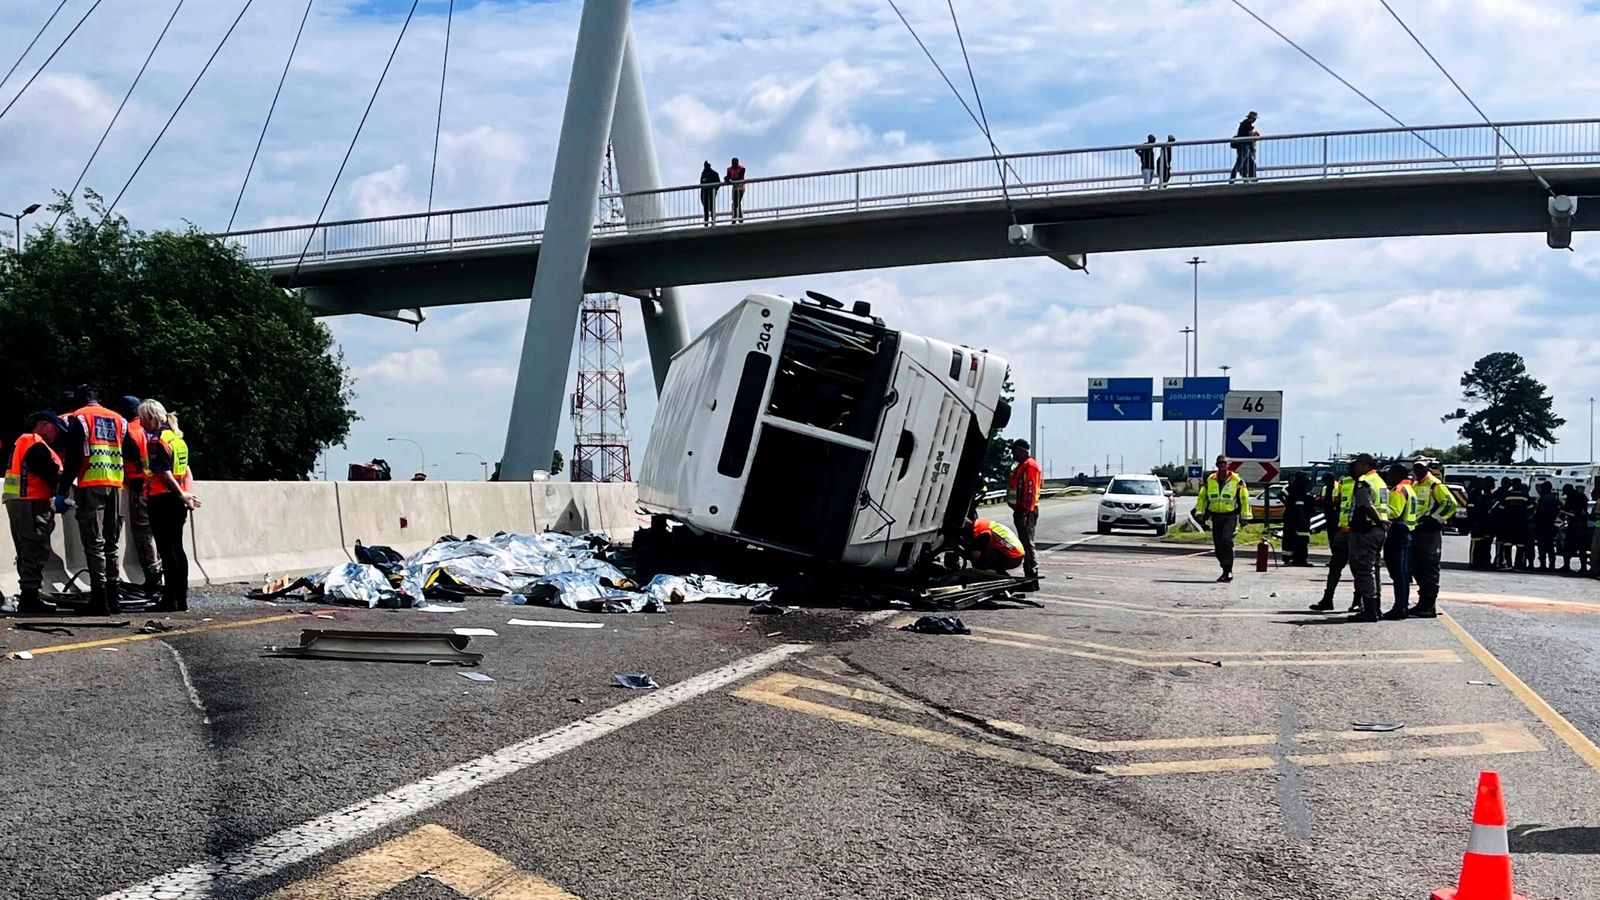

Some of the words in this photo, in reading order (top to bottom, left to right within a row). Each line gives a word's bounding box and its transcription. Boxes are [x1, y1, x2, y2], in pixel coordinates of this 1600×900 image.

[757, 323, 774, 352] 204
[1093, 379, 1102, 387] 46
[1168, 393, 1225, 402] Johannesburg
[1242, 396, 1265, 413] 46
